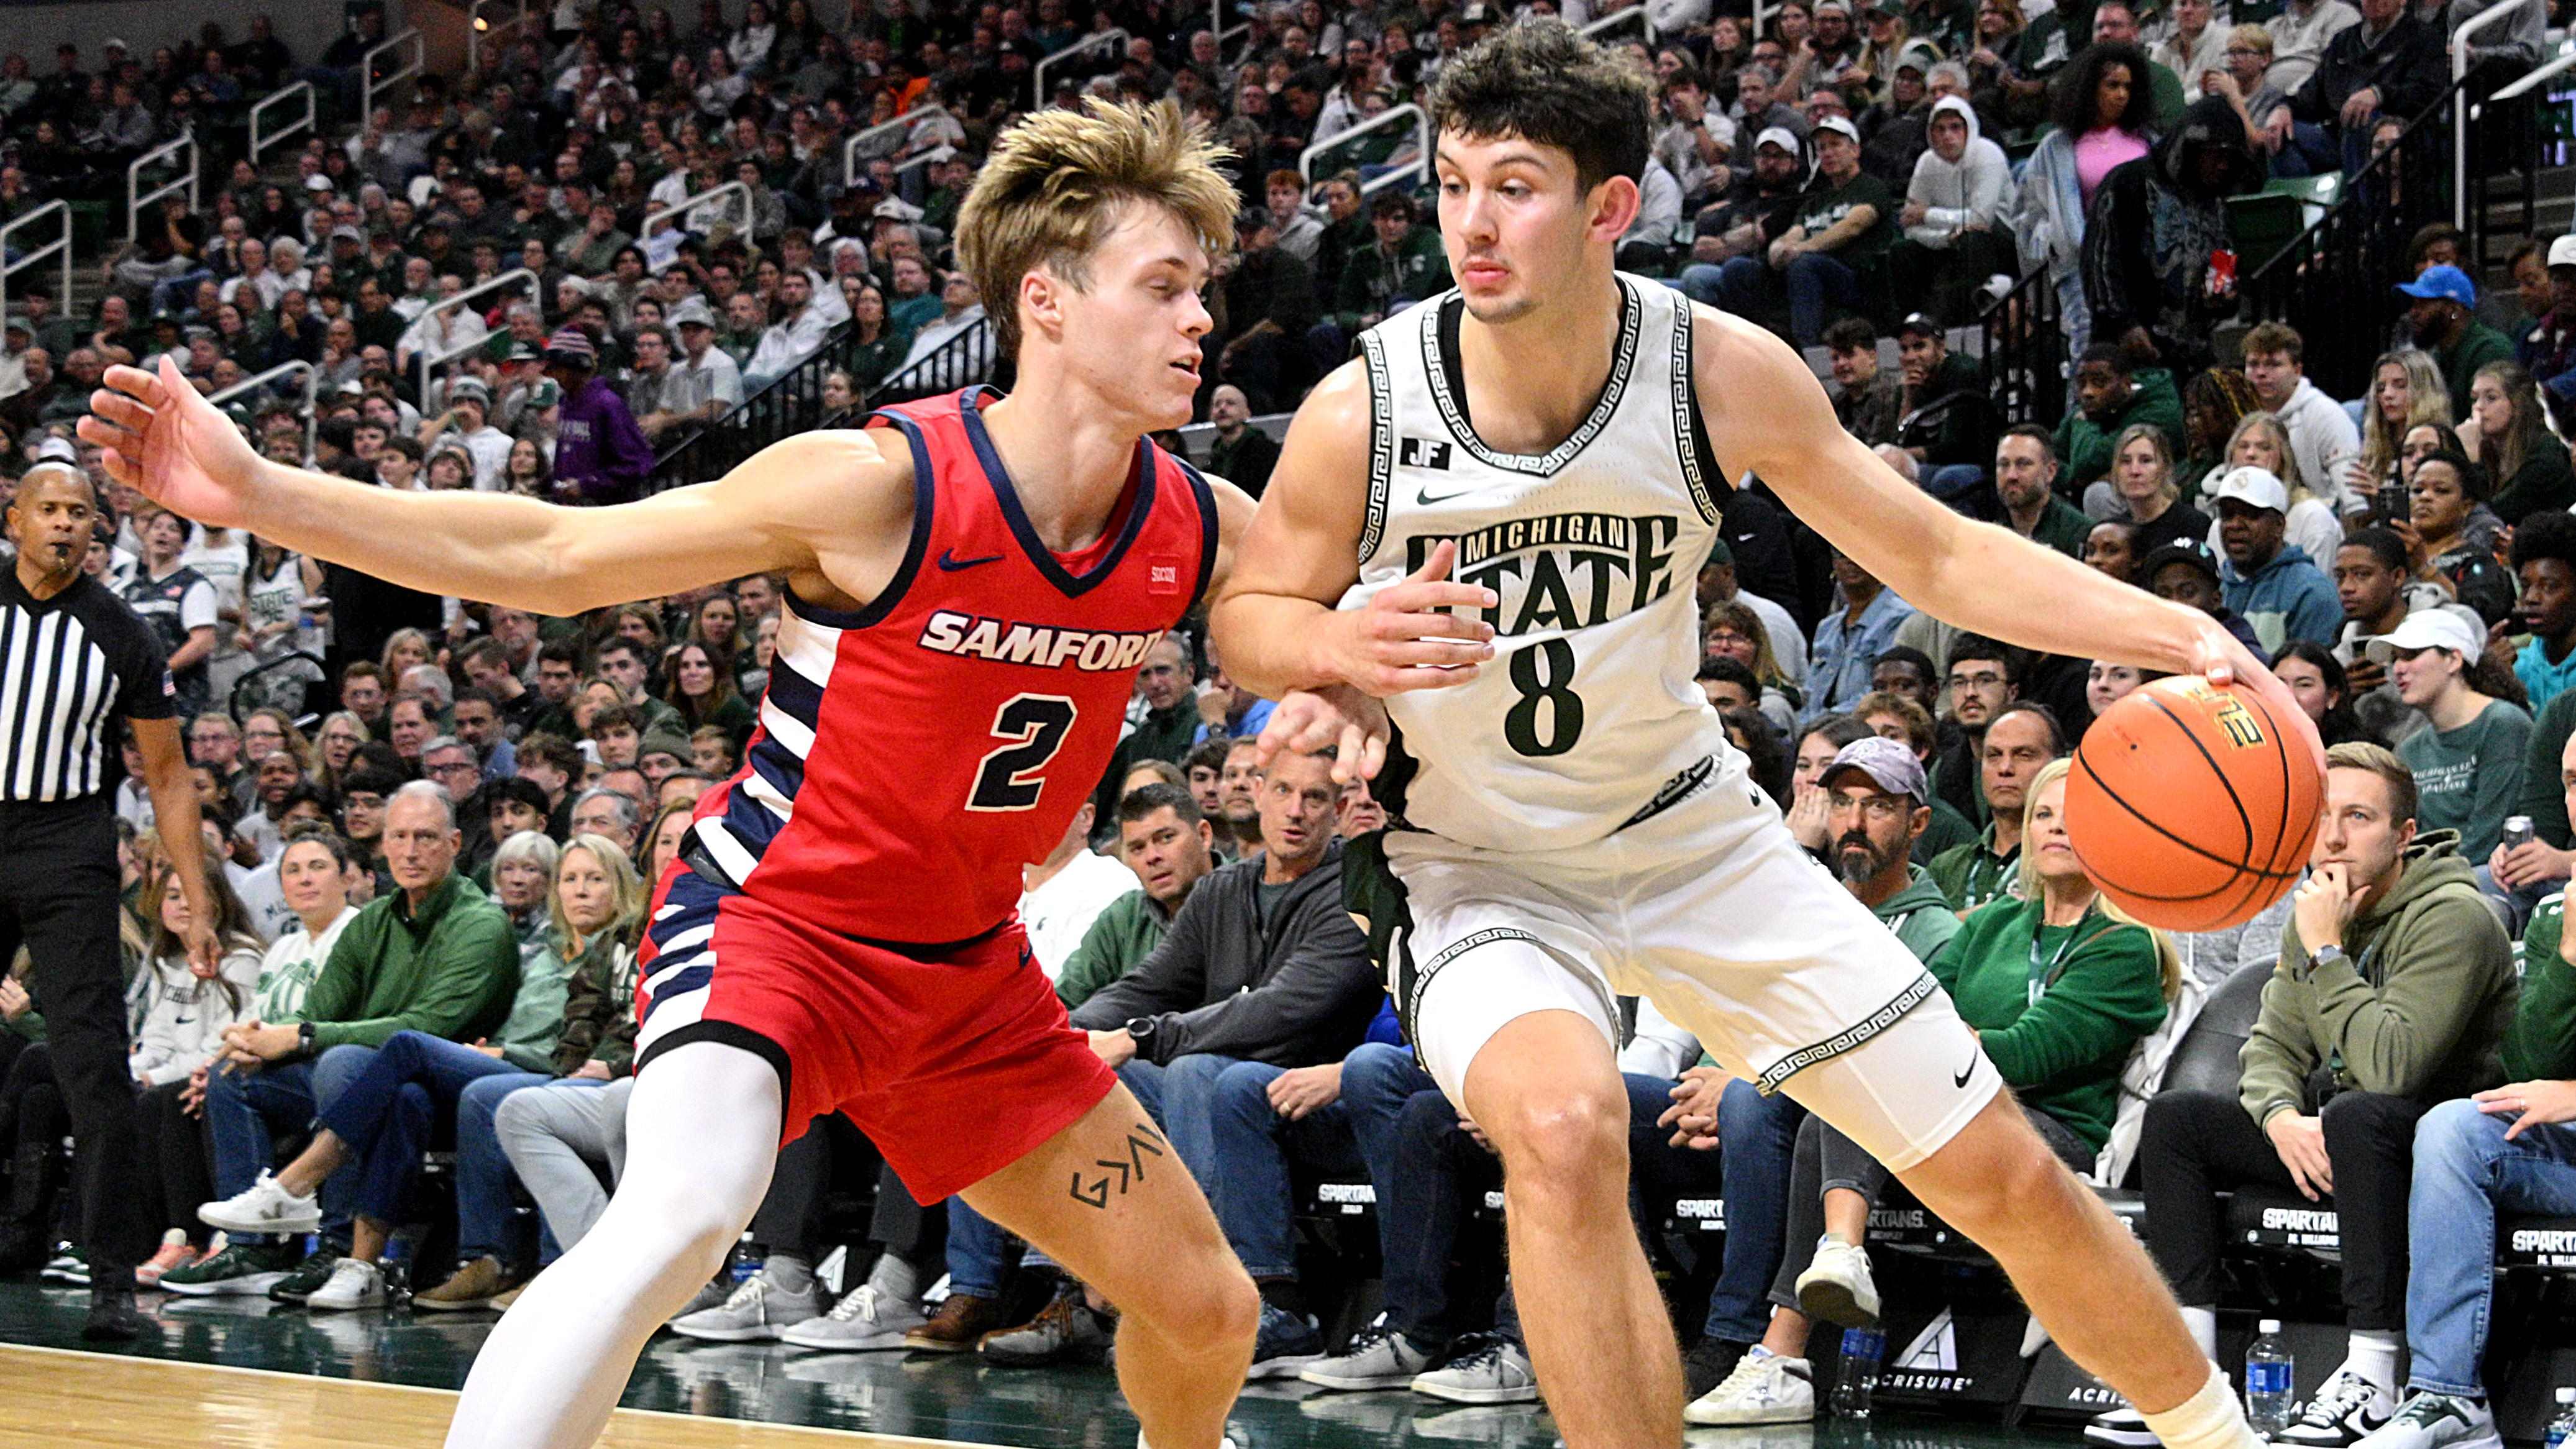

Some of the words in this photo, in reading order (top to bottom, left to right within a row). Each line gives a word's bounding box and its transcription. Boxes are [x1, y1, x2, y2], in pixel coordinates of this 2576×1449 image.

[1409, 439, 1443, 467] JF
[1465, 516, 1624, 564] MICHIGAN
[1505, 638, 1584, 756] 8
[964, 692, 1078, 812] 2
[1873, 1373, 1966, 1392] CRISURE
